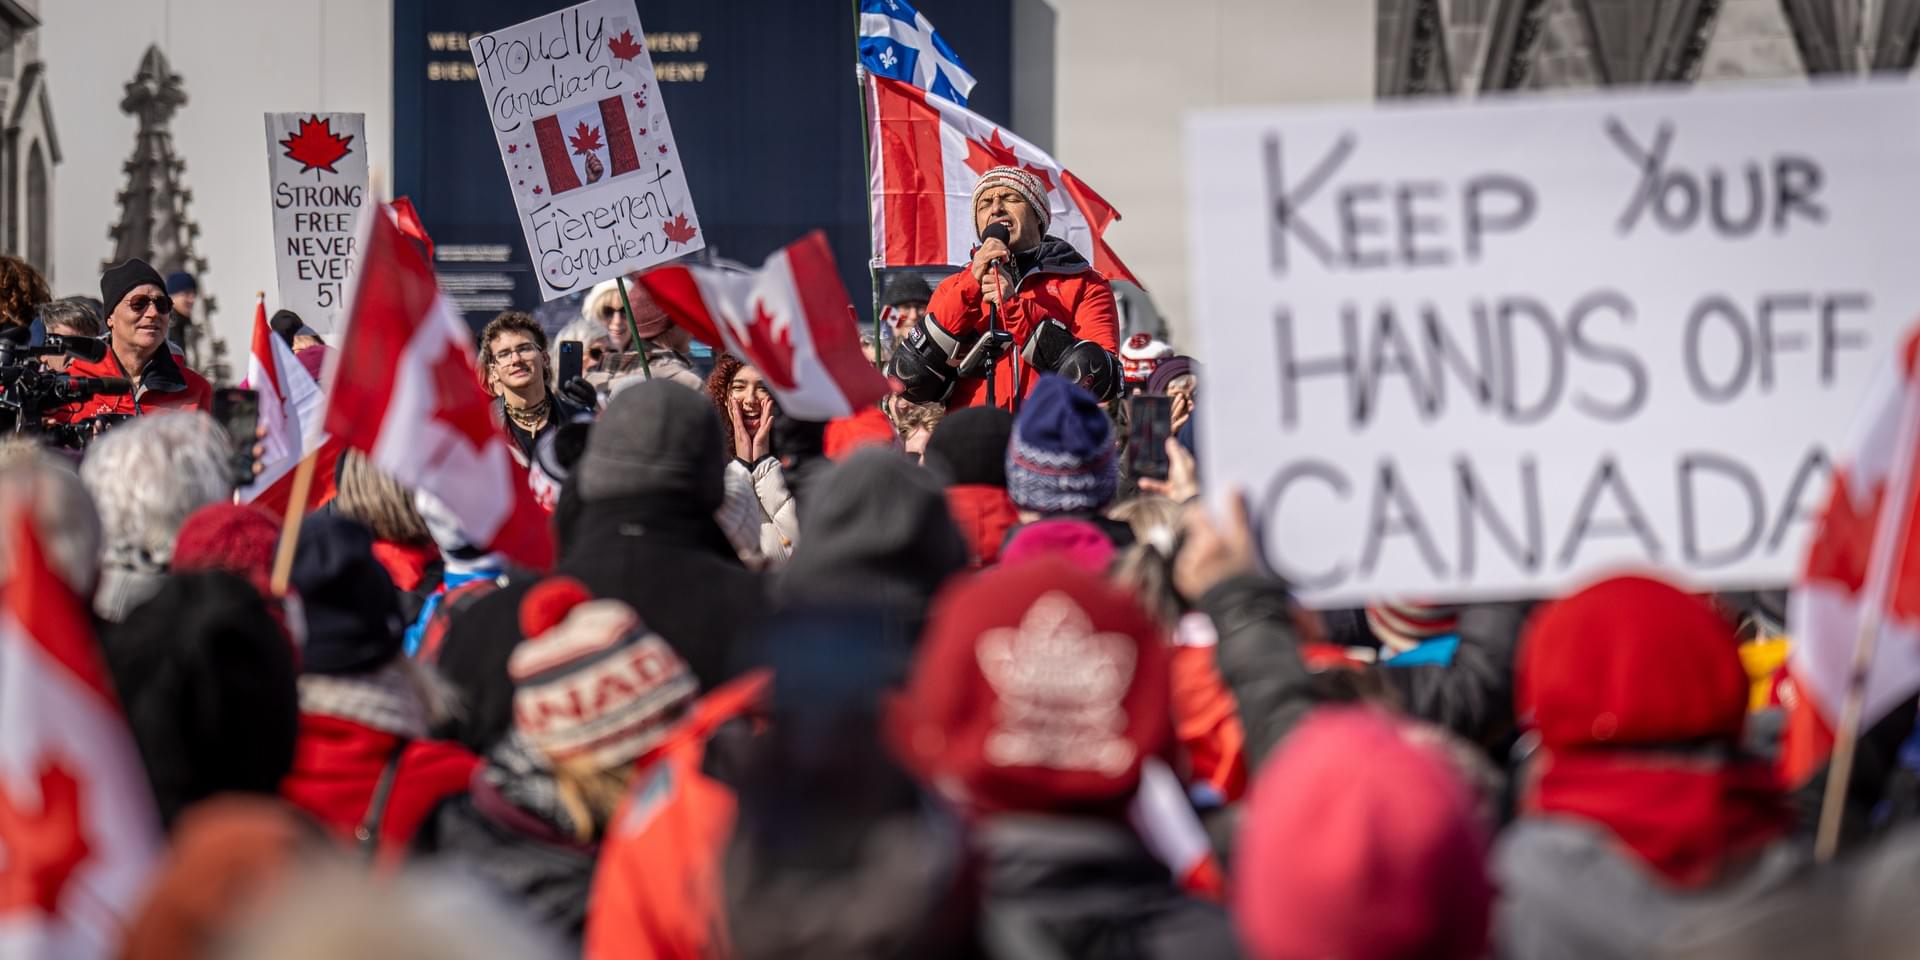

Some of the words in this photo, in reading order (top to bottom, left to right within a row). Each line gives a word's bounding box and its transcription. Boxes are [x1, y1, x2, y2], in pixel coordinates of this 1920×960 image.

[477, 9, 603, 85] Proudly
[493, 65, 622, 132] Canadian
[276, 182, 362, 209] STRONG
[295, 212, 351, 232] FREE
[529, 163, 672, 253] Fièrement
[1262, 131, 1538, 277] KEEP
[1606, 115, 1829, 238] YOUR
[287, 237, 358, 256] NEVER
[297, 258, 354, 281] EVER
[540, 229, 669, 290] Canadien
[1273, 289, 1650, 432] HANDS
[1682, 293, 1872, 404] OFF
